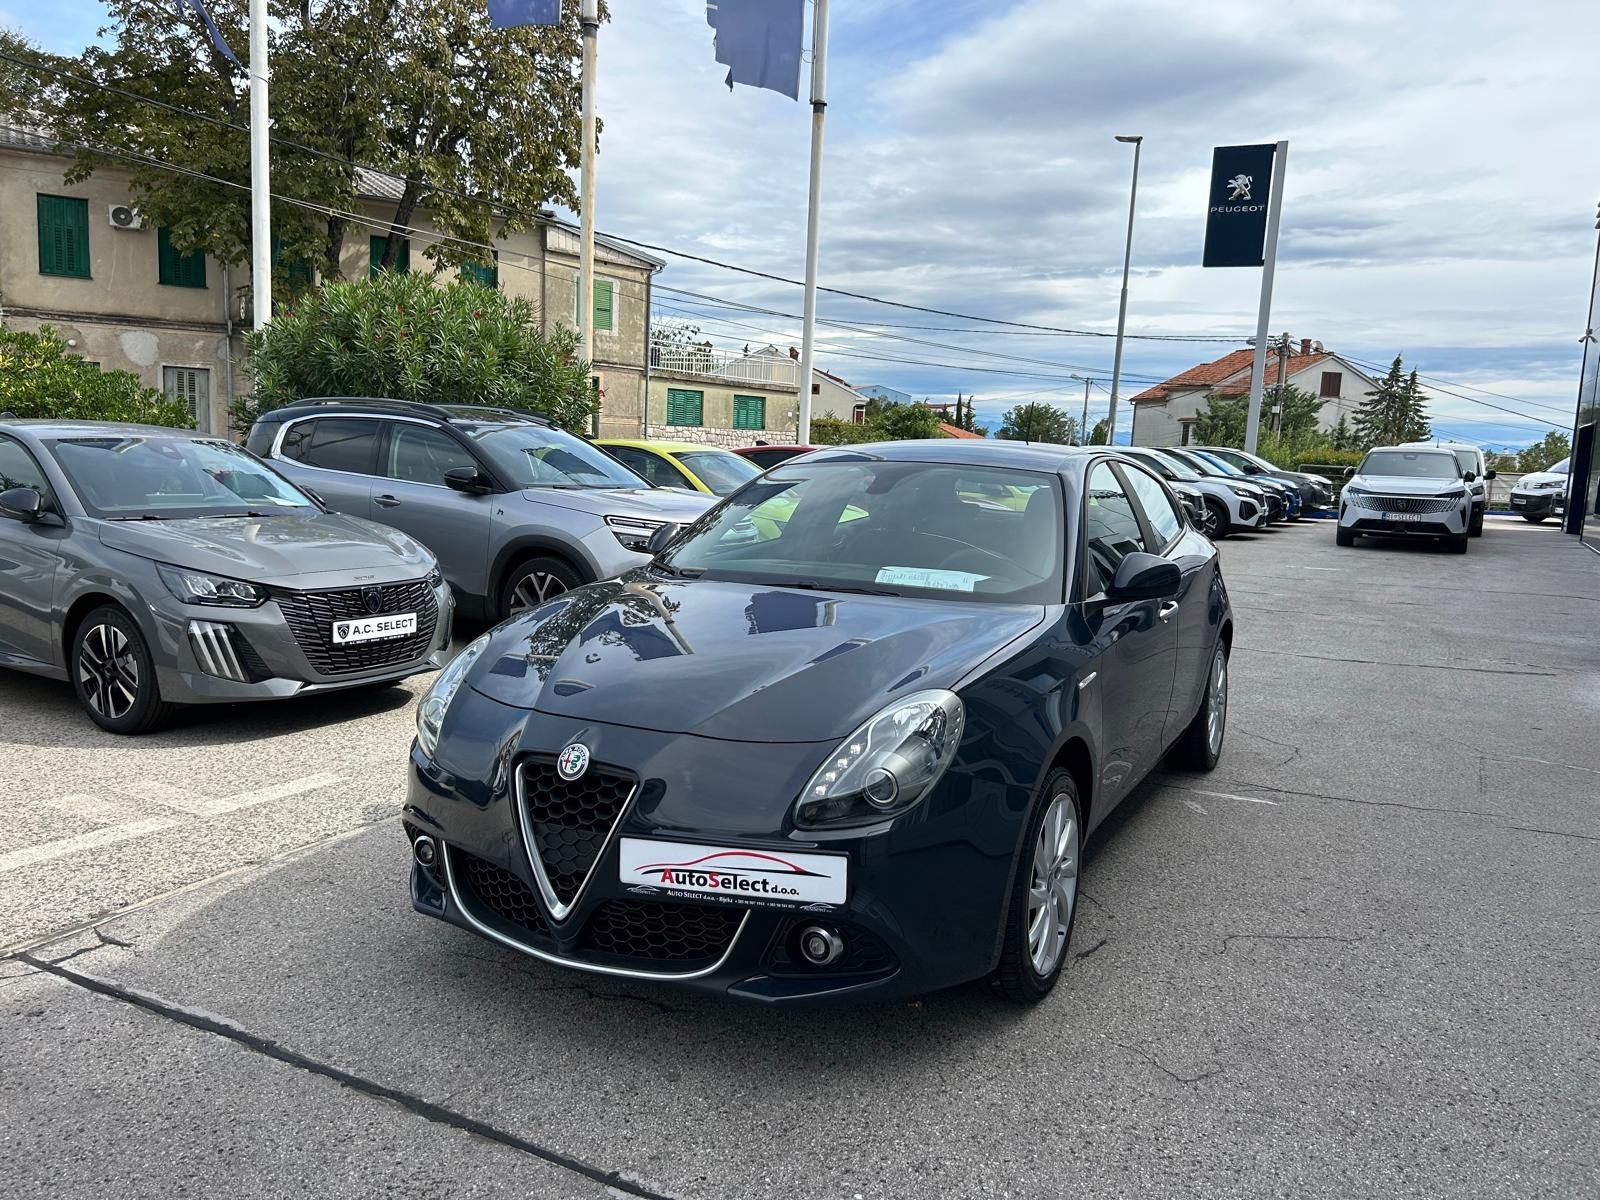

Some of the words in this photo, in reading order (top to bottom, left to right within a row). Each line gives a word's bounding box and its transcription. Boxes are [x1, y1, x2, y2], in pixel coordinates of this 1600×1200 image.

[1210, 205, 1265, 213] PEUGEOT
[352, 624, 374, 635] A.C.
[376, 618, 414, 632] SELECT
[660, 868, 770, 893] AutoSelect
[770, 884, 800, 896] d.o.o.
[666, 889, 683, 897] AUTO
[683, 891, 703, 899] SELECT
